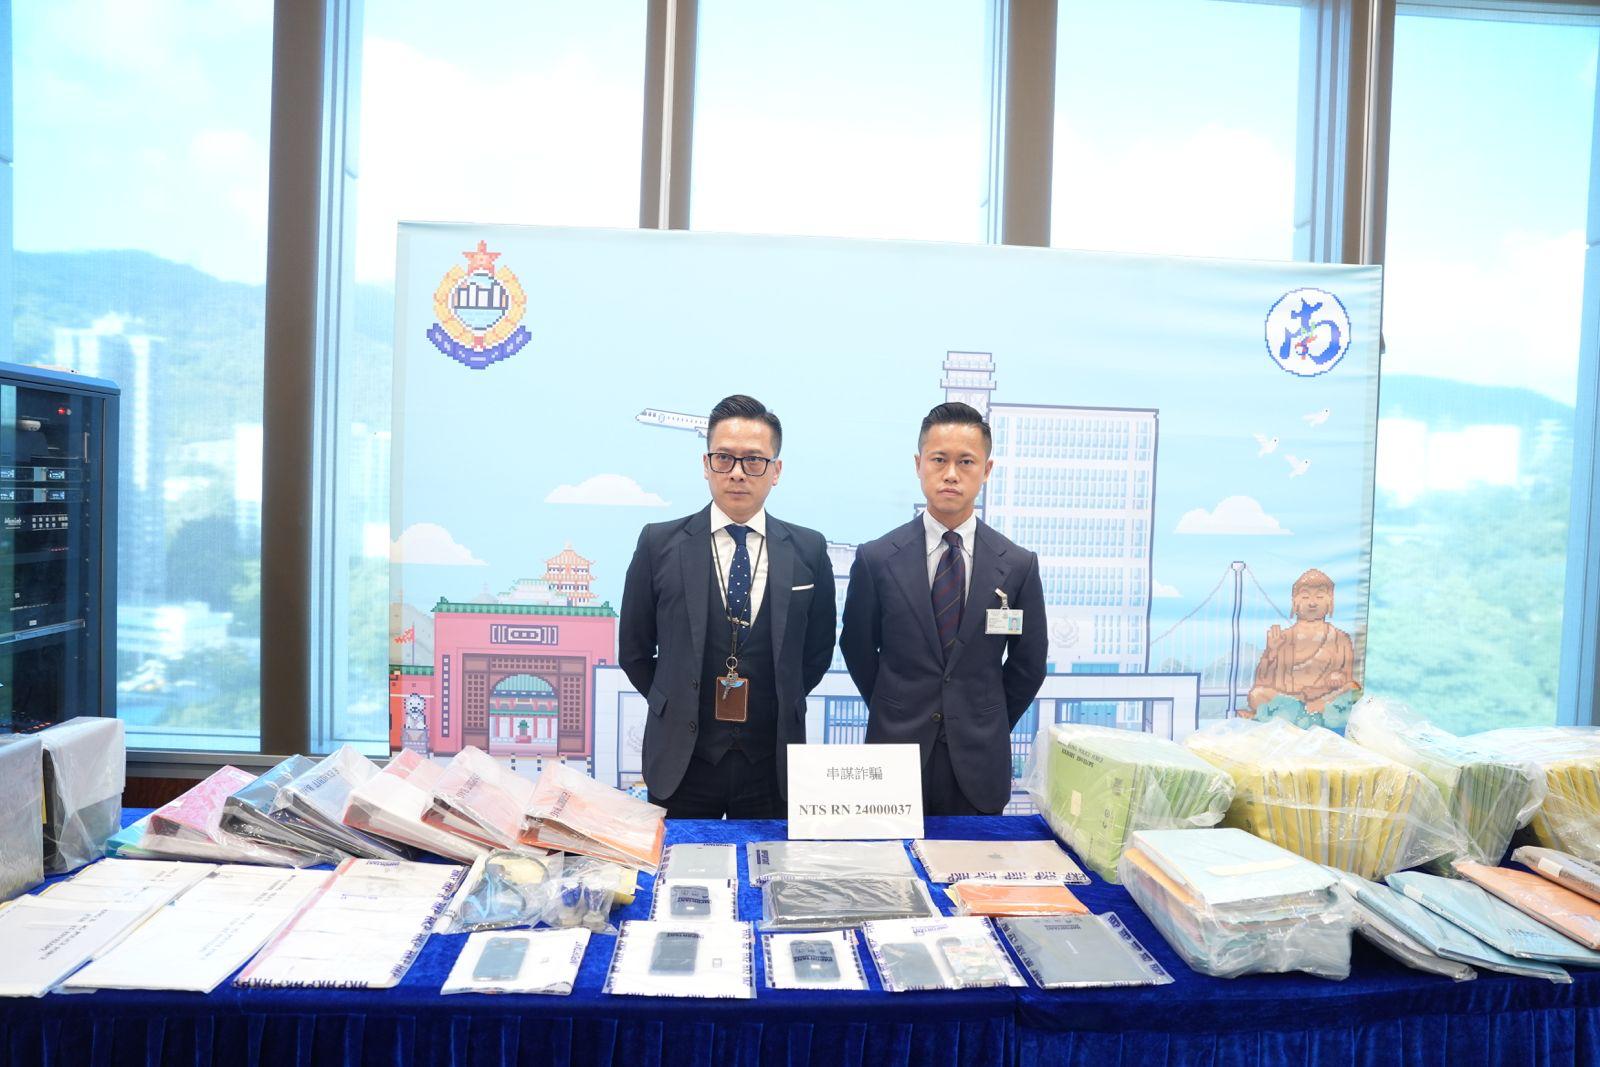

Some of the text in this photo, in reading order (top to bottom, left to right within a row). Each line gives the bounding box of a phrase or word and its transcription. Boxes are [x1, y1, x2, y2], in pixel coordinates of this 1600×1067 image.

[826, 766, 883, 781] 串謀詐騙
[799, 804, 912, 815] NTS RN 24000037
